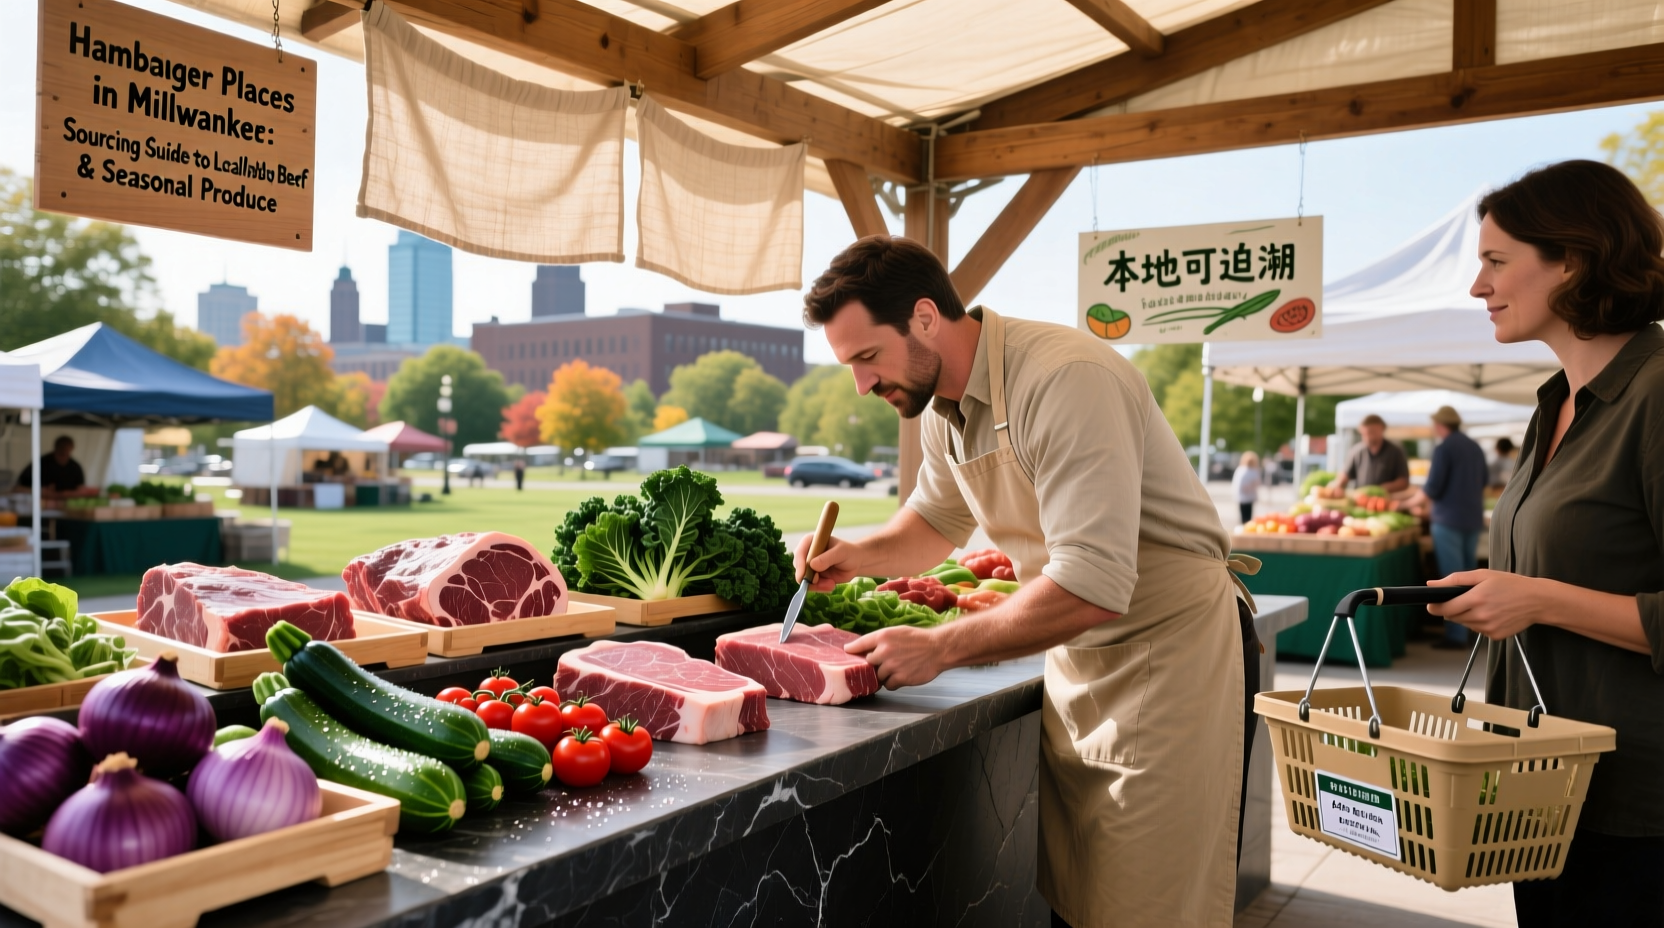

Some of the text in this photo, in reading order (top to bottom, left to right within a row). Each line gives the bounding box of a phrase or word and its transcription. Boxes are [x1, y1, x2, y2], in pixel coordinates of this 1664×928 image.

[93, 75, 118, 109] in
[221, 66, 295, 113] Places
[63, 117, 140, 162] Sourcing
[193, 149, 210, 170] to
[77, 153, 277, 213] & Seasonal Produce
